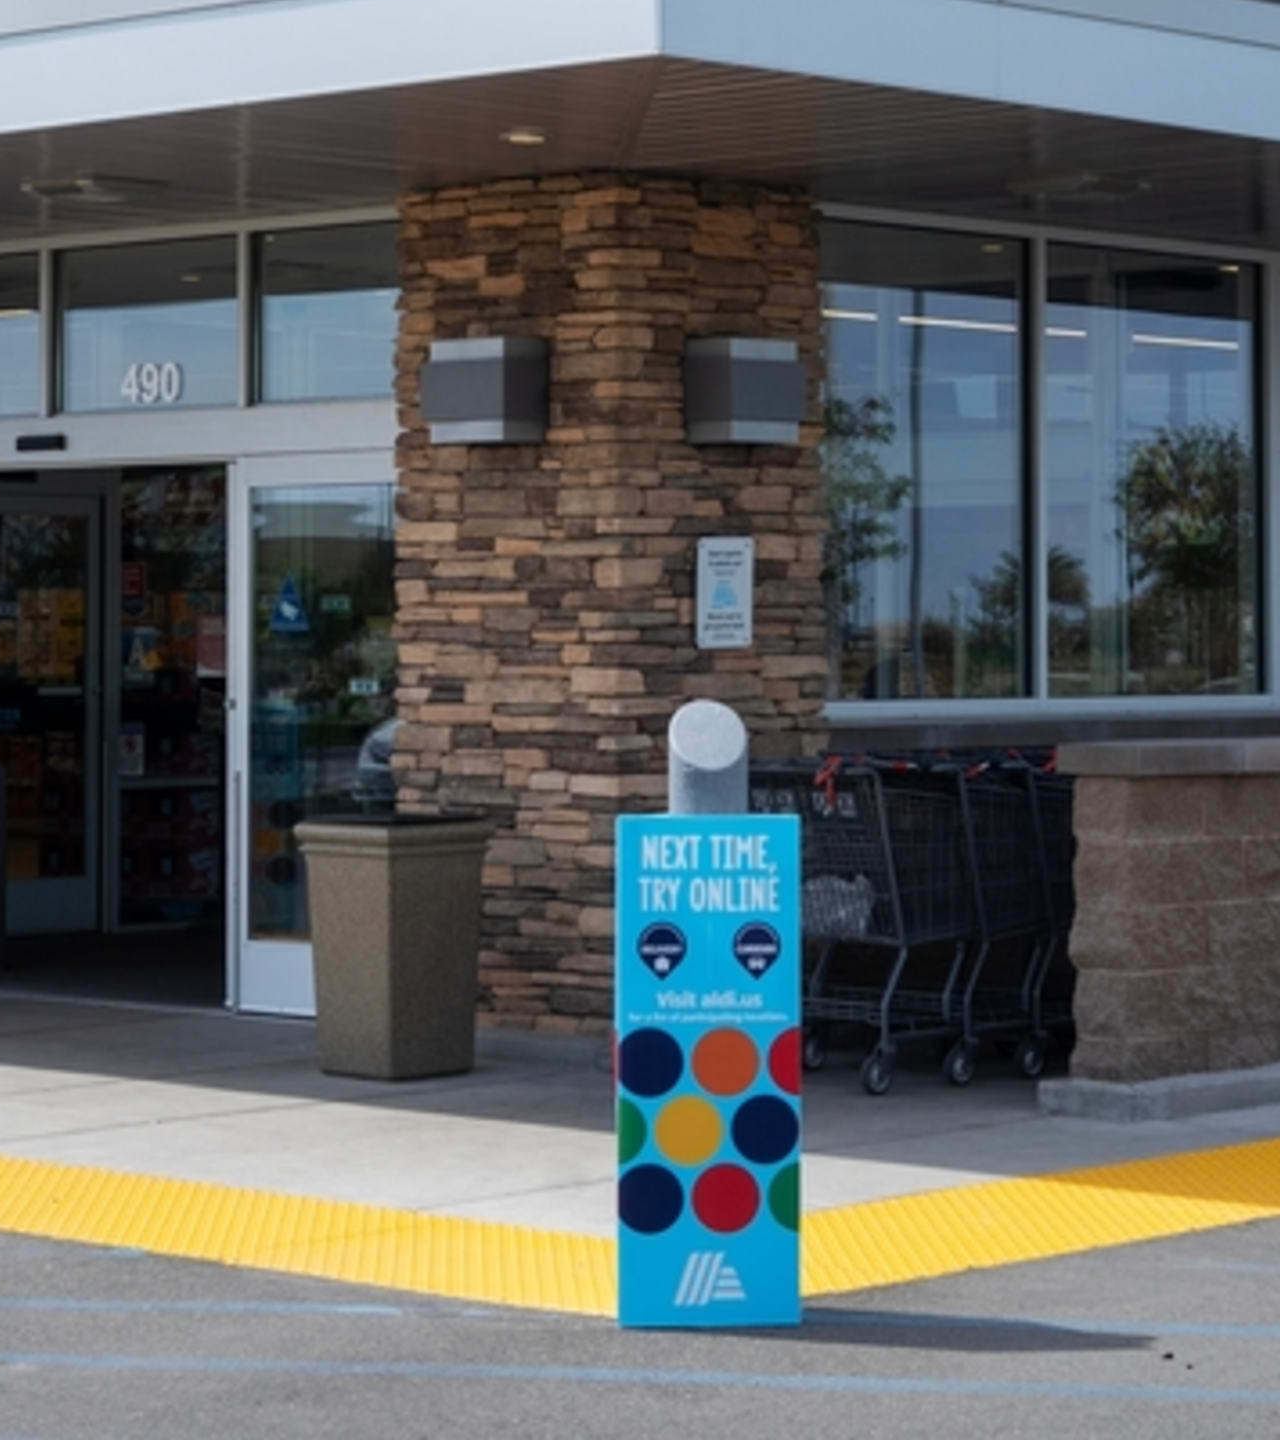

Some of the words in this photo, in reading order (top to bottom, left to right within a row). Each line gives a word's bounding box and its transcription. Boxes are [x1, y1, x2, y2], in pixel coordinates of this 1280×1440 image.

[121, 363, 181, 402] 490
[642, 835, 701, 871] NEXT
[709, 835, 777, 874] TIME,
[638, 877, 681, 912] TRY
[689, 877, 780, 912] ONLINE
[656, 991, 696, 1009] Visit
